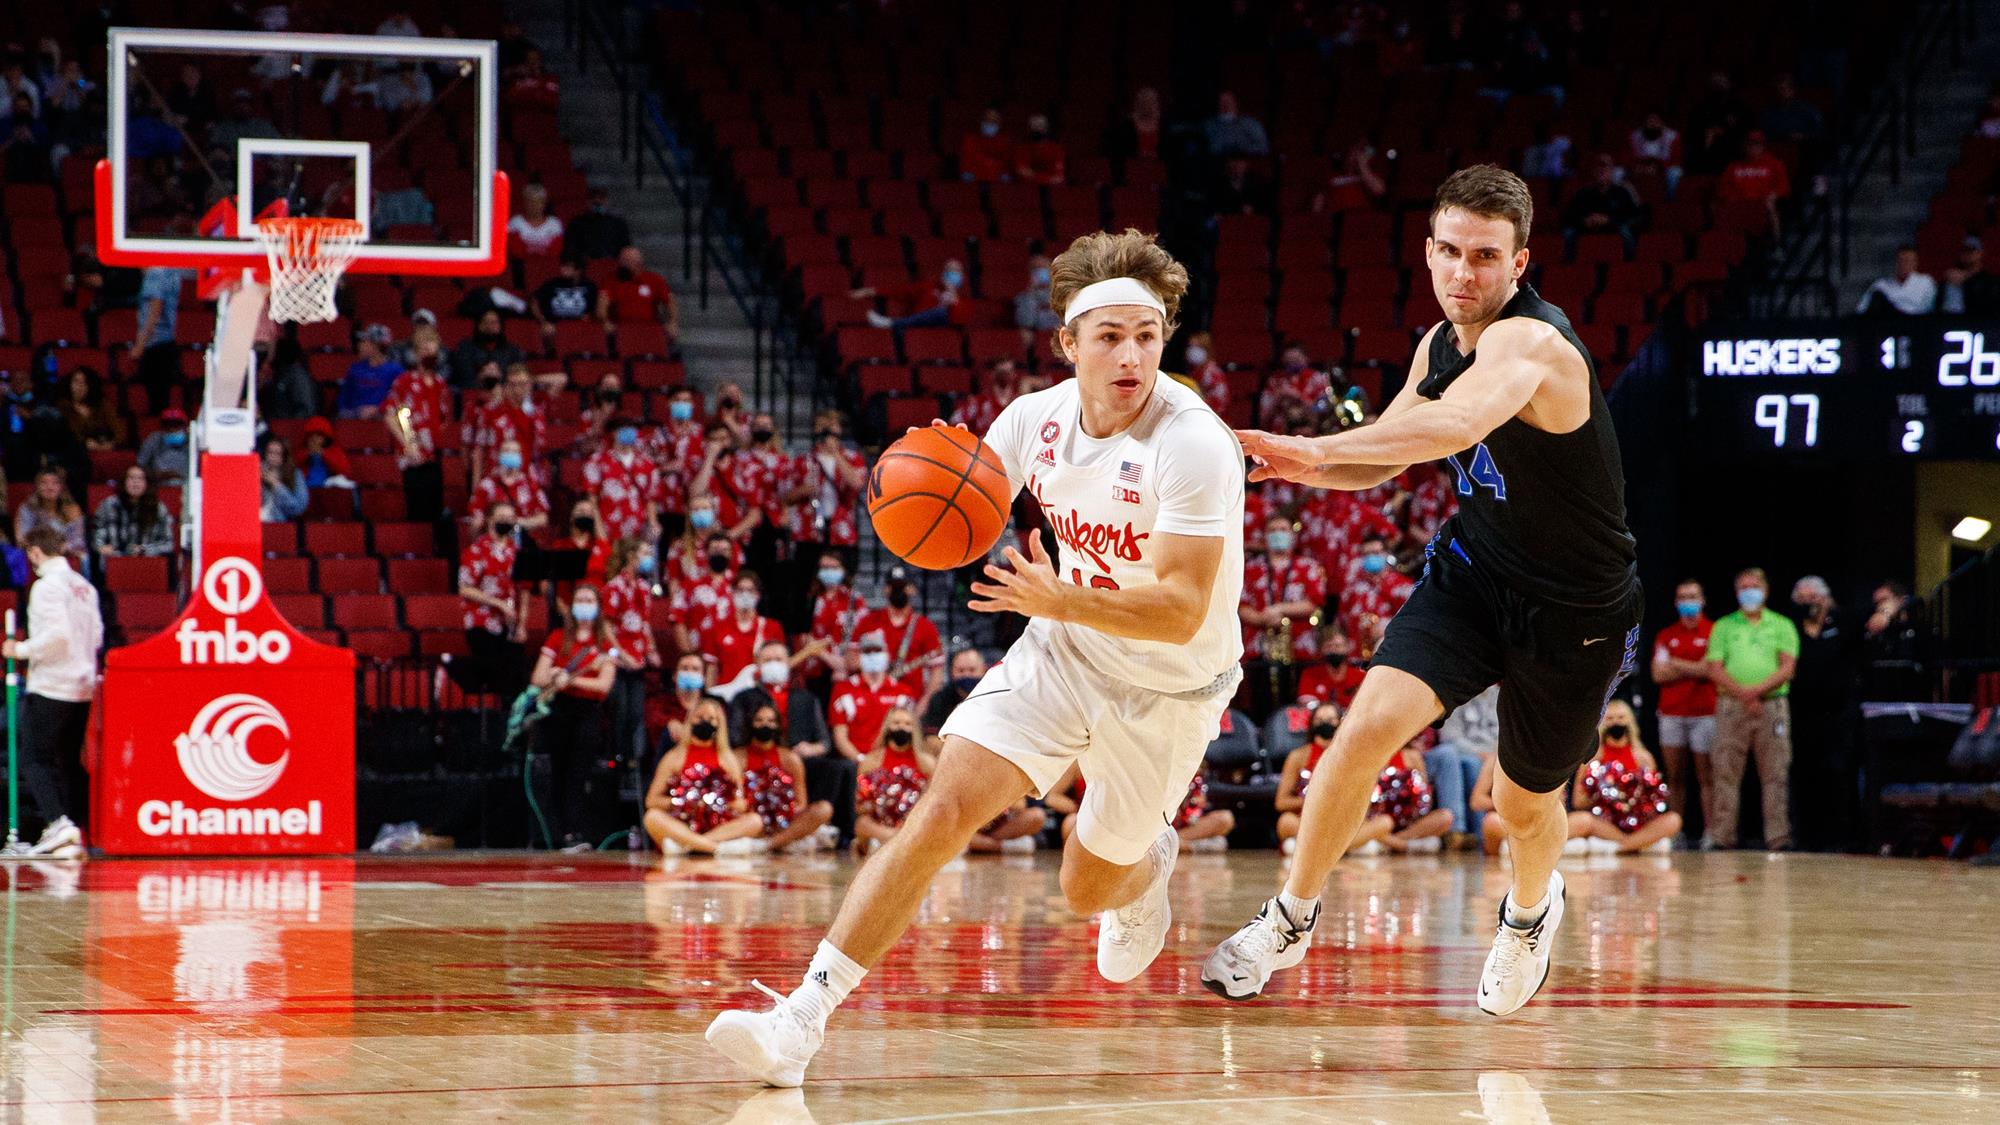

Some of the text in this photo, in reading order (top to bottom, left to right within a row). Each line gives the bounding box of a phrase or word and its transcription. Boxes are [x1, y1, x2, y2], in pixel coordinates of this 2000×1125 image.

[1703, 338, 1841, 376] HUSKERS
[1755, 393, 1820, 447] 97
[1901, 420, 1925, 453] 2
[176, 617, 291, 664] fnbo
[136, 799, 322, 835] Channel
